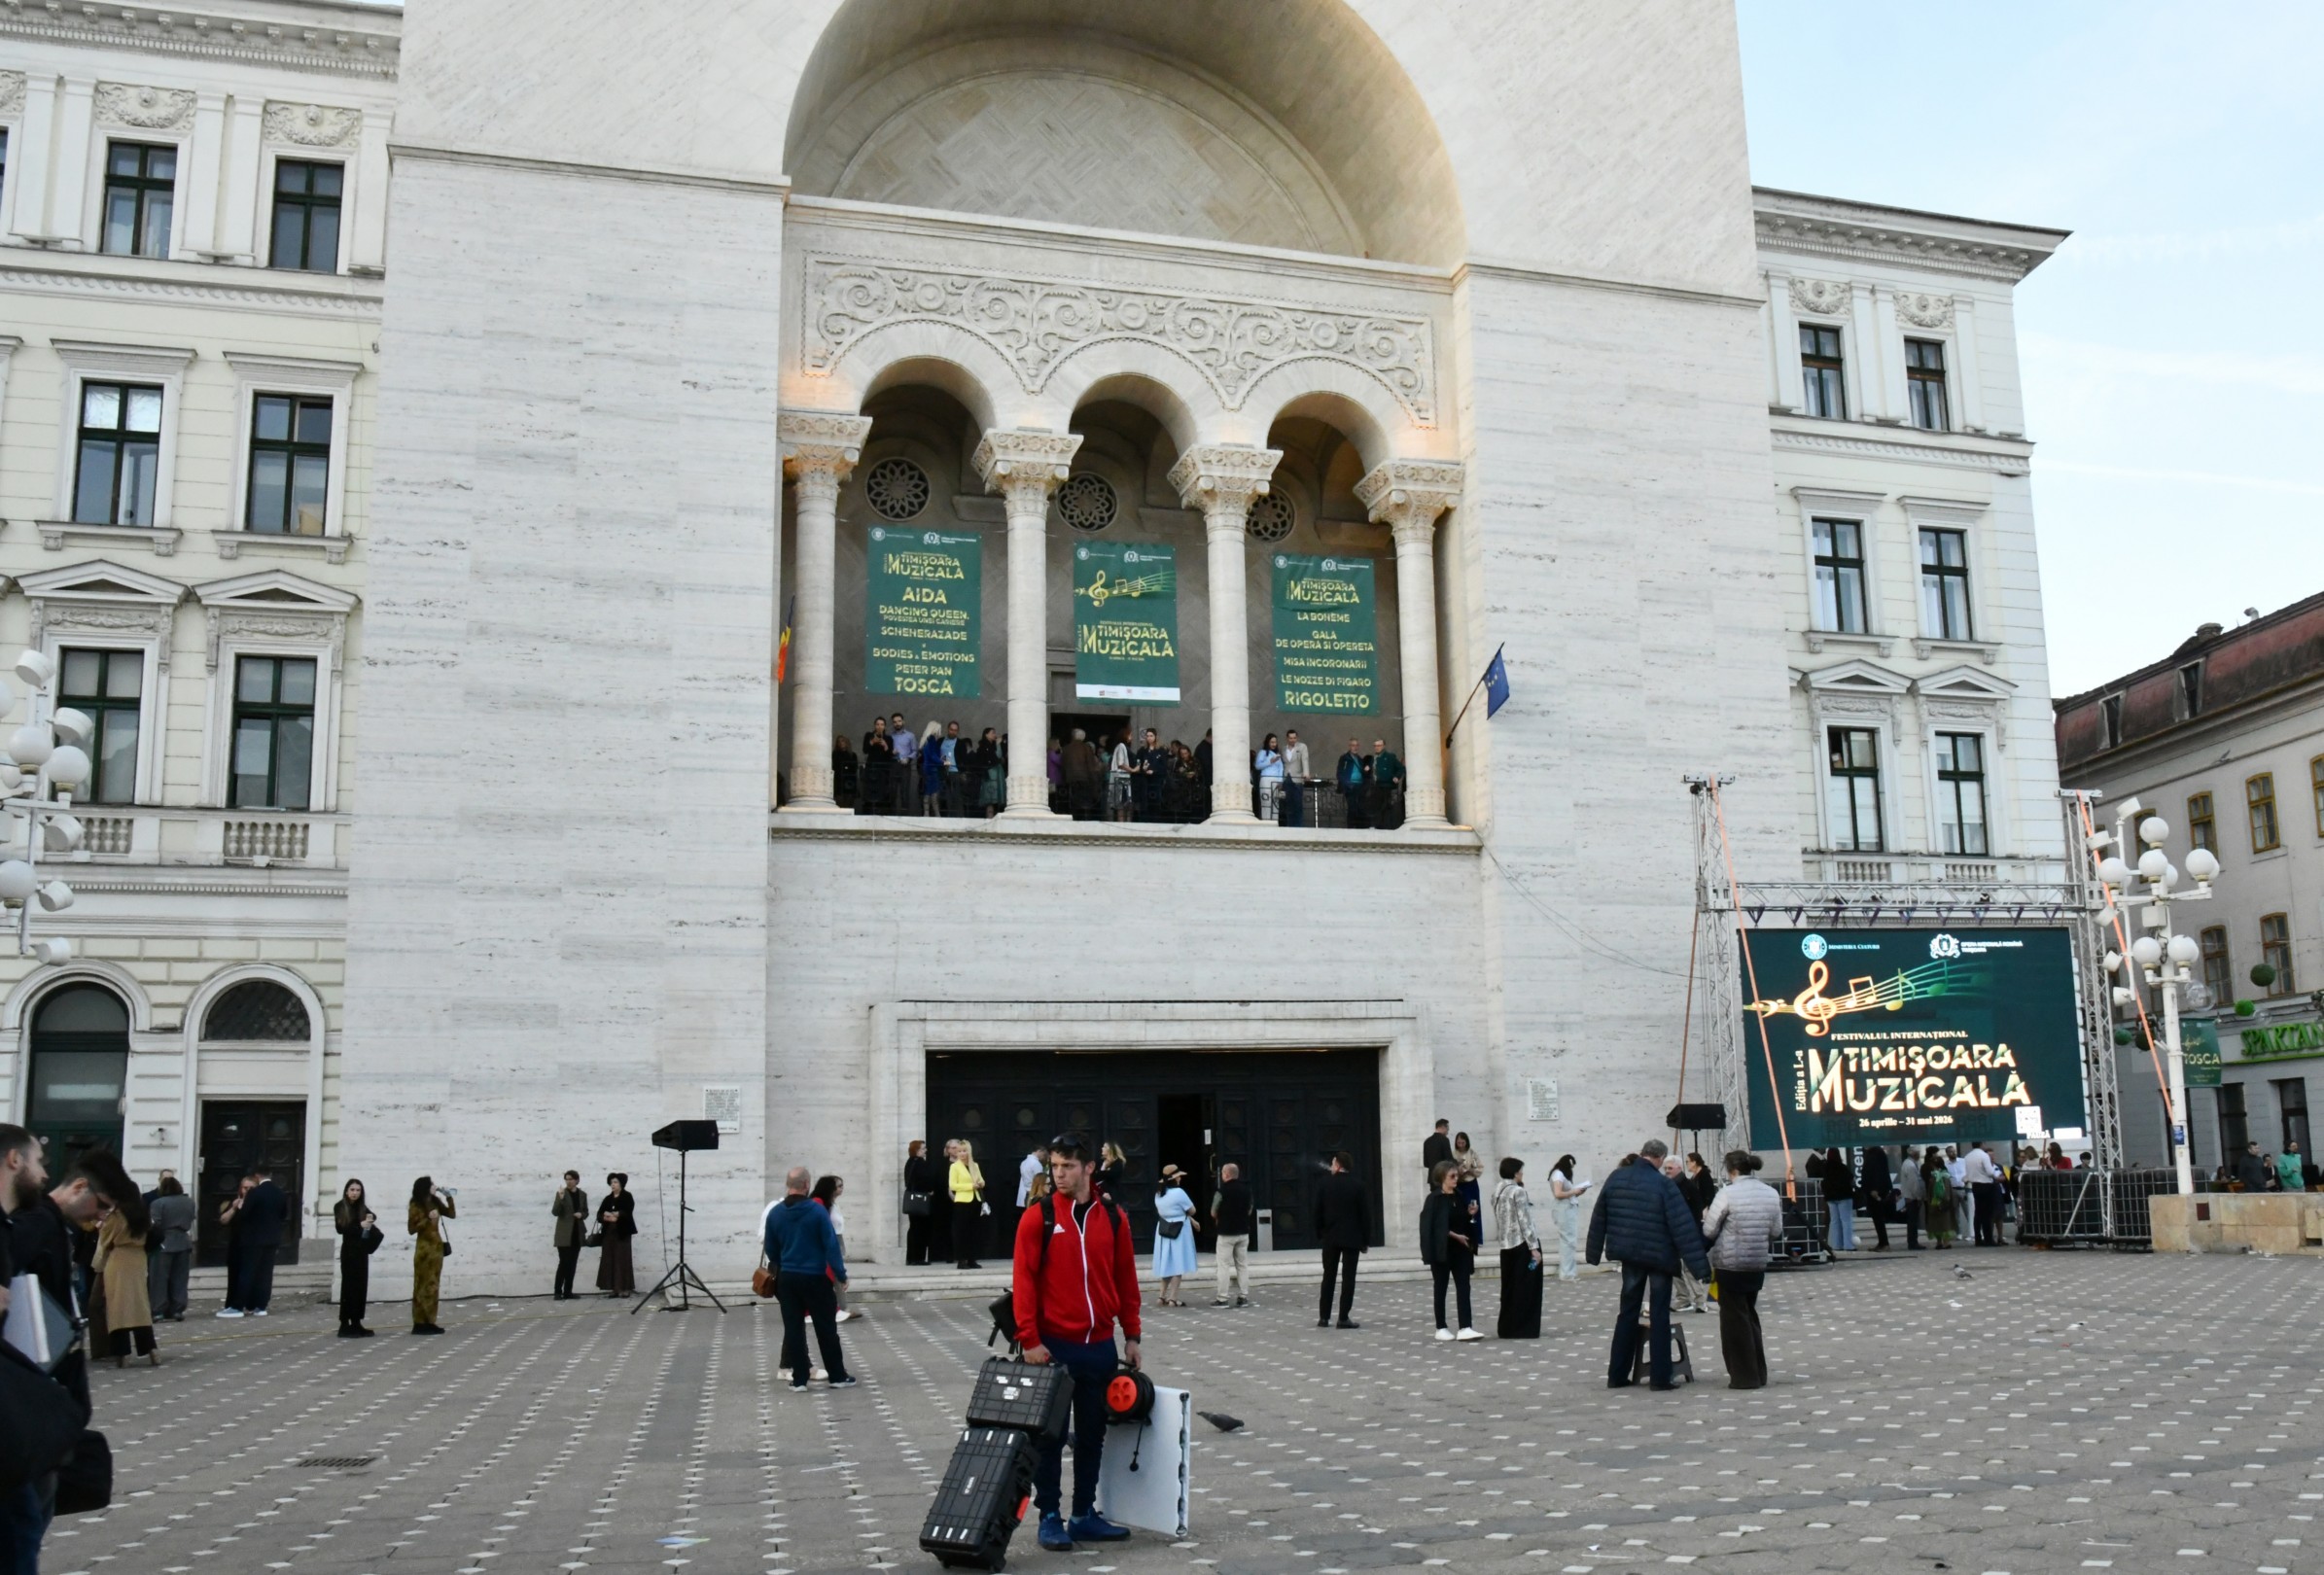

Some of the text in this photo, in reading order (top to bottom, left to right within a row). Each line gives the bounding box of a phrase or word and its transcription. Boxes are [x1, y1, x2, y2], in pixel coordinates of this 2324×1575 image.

[902, 586, 947, 604] AIDA
[879, 605, 928, 617] DANCING
[1297, 612, 1309, 620] LA
[881, 626, 968, 641] SCHEHERAZADE
[1312, 630, 1337, 640] GALA
[1276, 639, 1288, 648] DE
[872, 648, 913, 659] BODIES
[921, 650, 975, 663] EMOTIONS
[1284, 657, 1305, 666] MISA
[896, 664, 952, 676] PETER PAN
[895, 677, 953, 694] TOSCA
[1281, 674, 1371, 687] LE NOZZE DI FIGARO
[1285, 690, 1369, 709] RIGOLETTO
[1831, 1032, 1889, 1041] FESTIVALUL
[1843, 1043, 2017, 1079] TIMIȘOARA
[2184, 1053, 2220, 1065] TOSCA
[1808, 1047, 2032, 1113] MUZICALĂ
[1859, 1118, 1870, 1127] 26
[1871, 1117, 1898, 1129] aprilie
[1905, 1116, 1915, 1126] 31
[1917, 1116, 1933, 1125] mai
[1933, 1115, 1954, 1125] 2026
